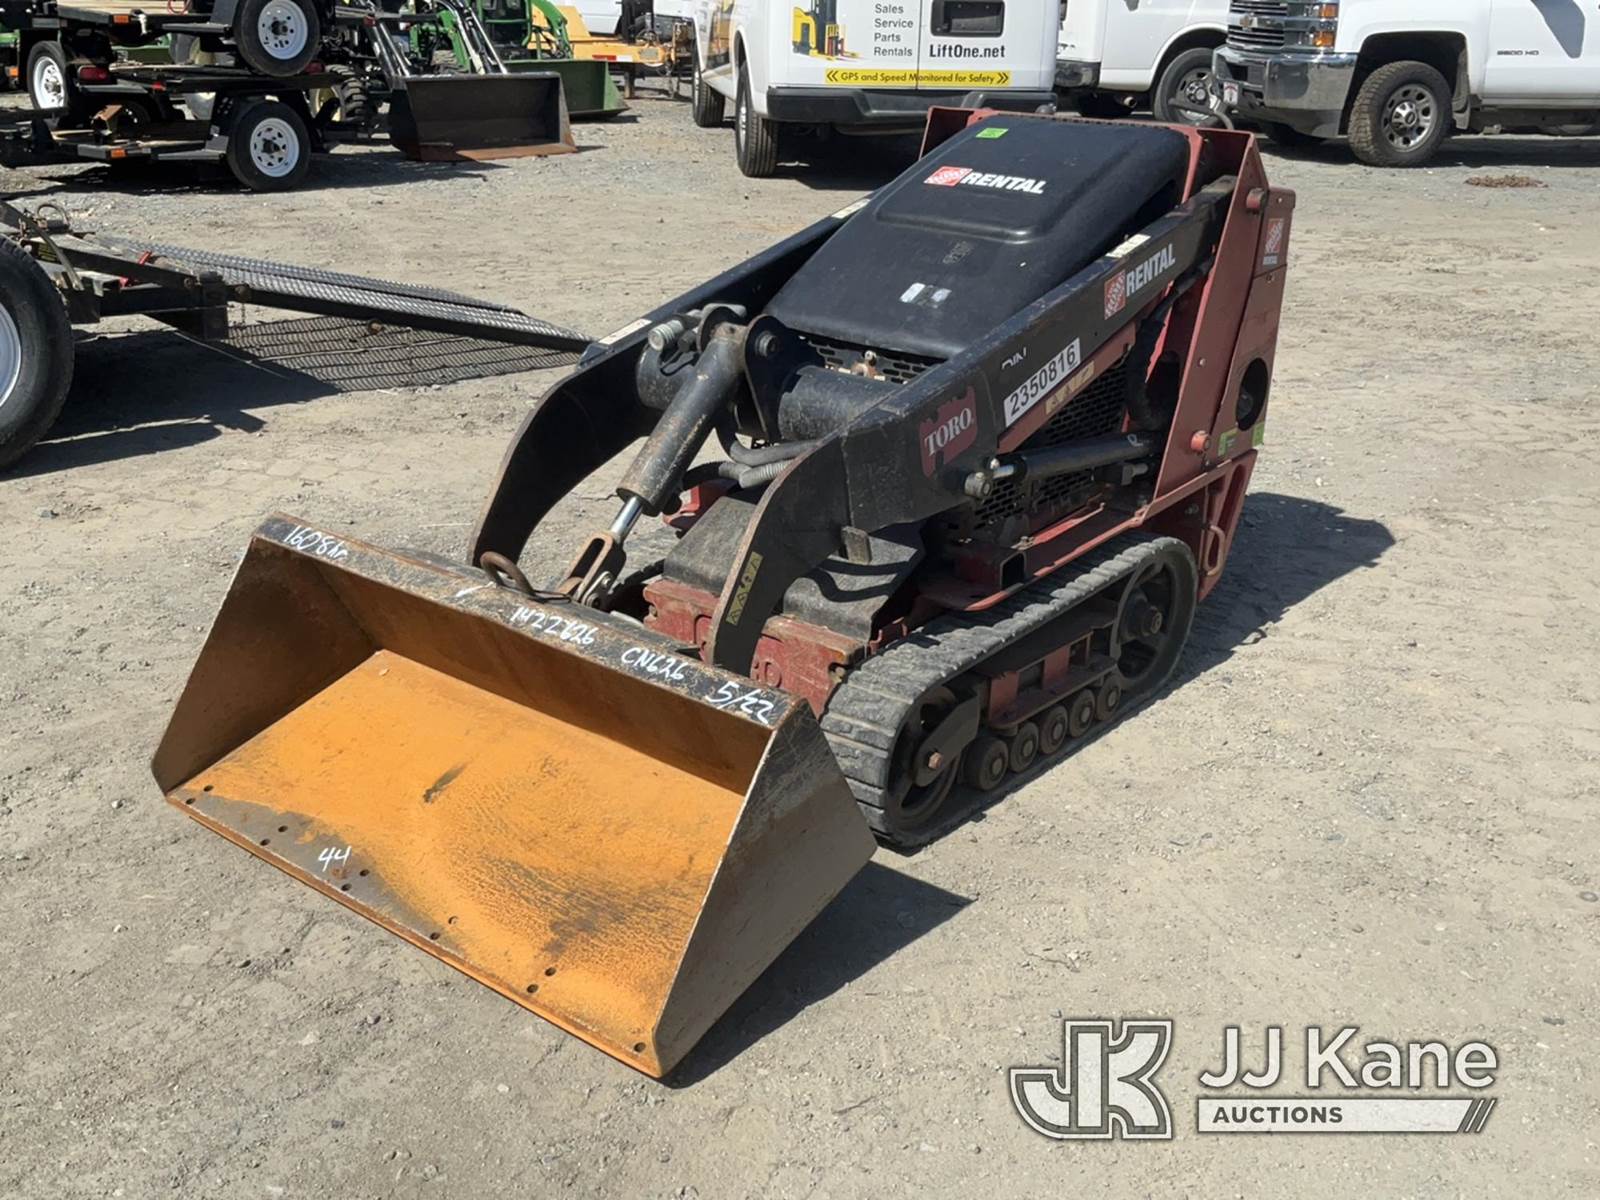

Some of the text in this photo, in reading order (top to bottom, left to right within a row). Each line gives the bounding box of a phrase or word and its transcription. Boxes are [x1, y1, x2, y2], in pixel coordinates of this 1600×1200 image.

[874, 3, 904, 14] Sales
[874, 18, 914, 28] Service
[873, 32, 901, 42] Parts
[873, 46, 913, 56] Rentals
[929, 44, 1006, 58] LiftOne.net
[840, 71, 994, 84] GPS and Speed Monitored for Safety
[960, 171, 1047, 195] RENTAL
[1126, 243, 1176, 297] RENTAL
[1009, 344, 1076, 417] 2350816
[923, 407, 972, 457] TORO
